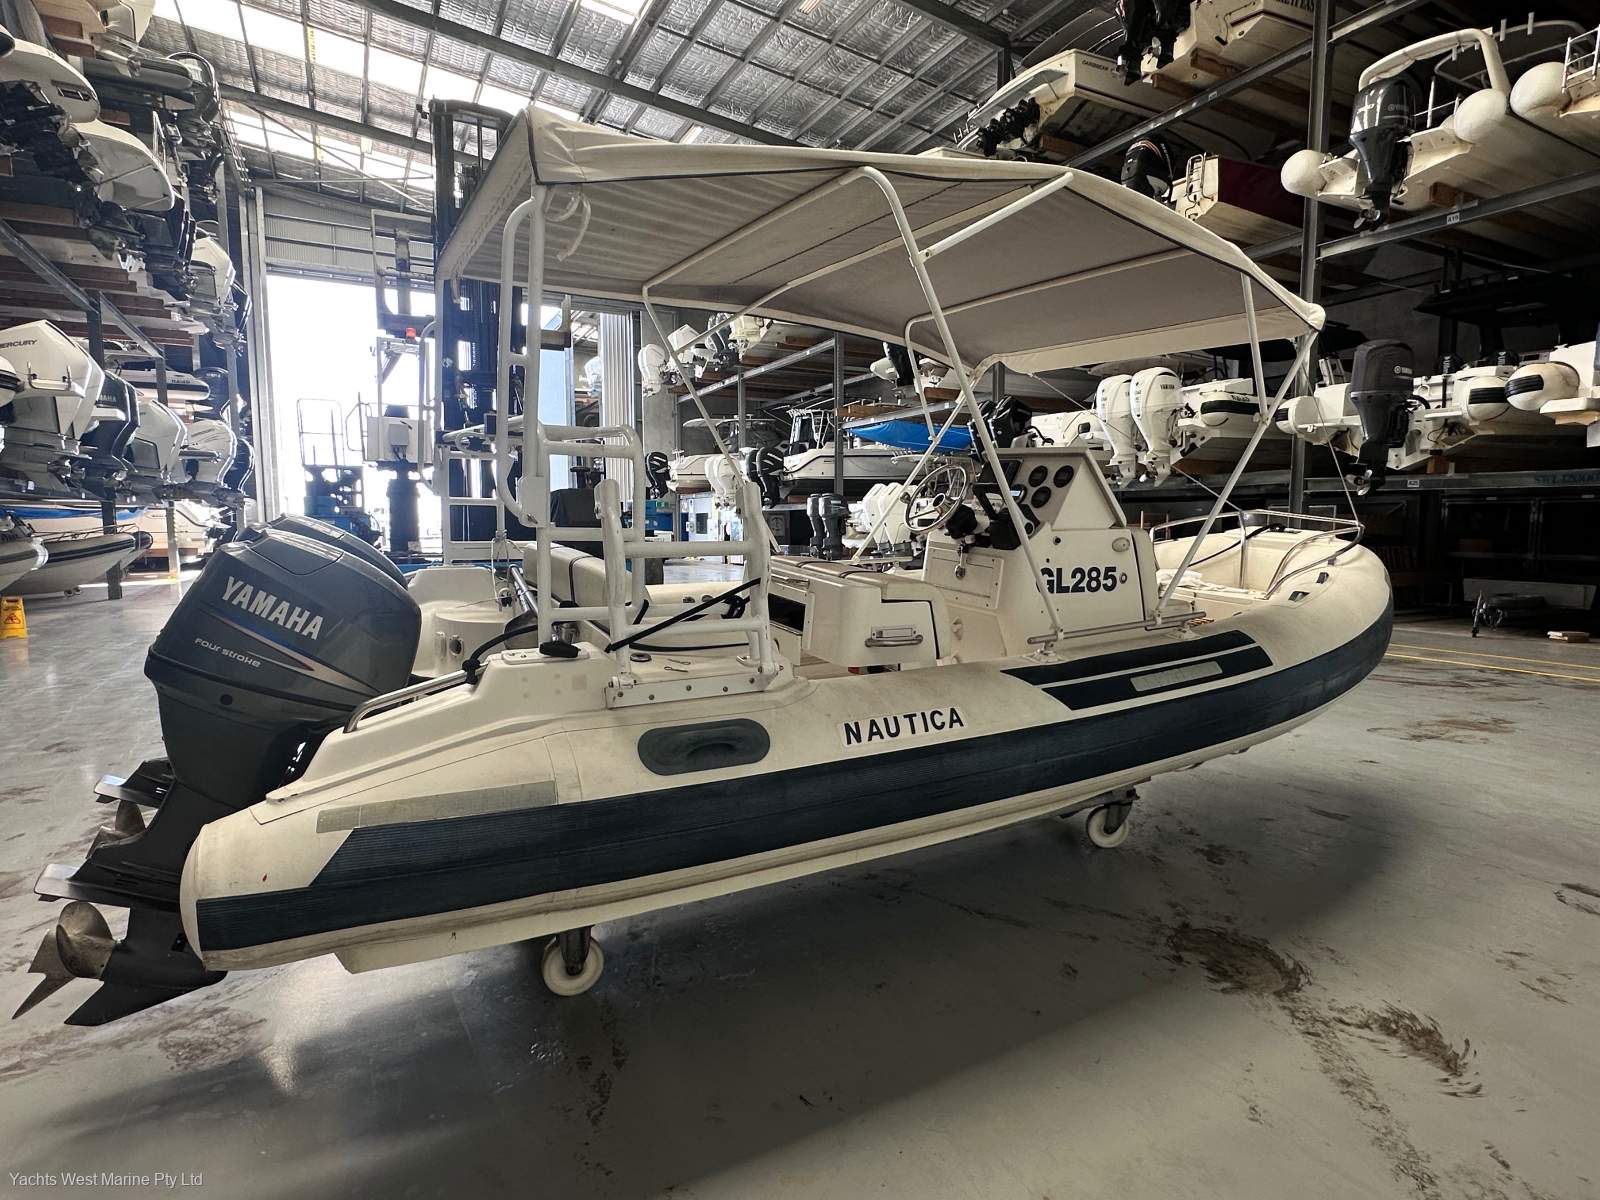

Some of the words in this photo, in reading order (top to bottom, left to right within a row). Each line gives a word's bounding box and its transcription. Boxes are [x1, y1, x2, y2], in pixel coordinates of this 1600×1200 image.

[1036, 566, 1117, 594] GL285
[222, 576, 323, 640] YAMAHA
[843, 707, 964, 745] NAUTICA
